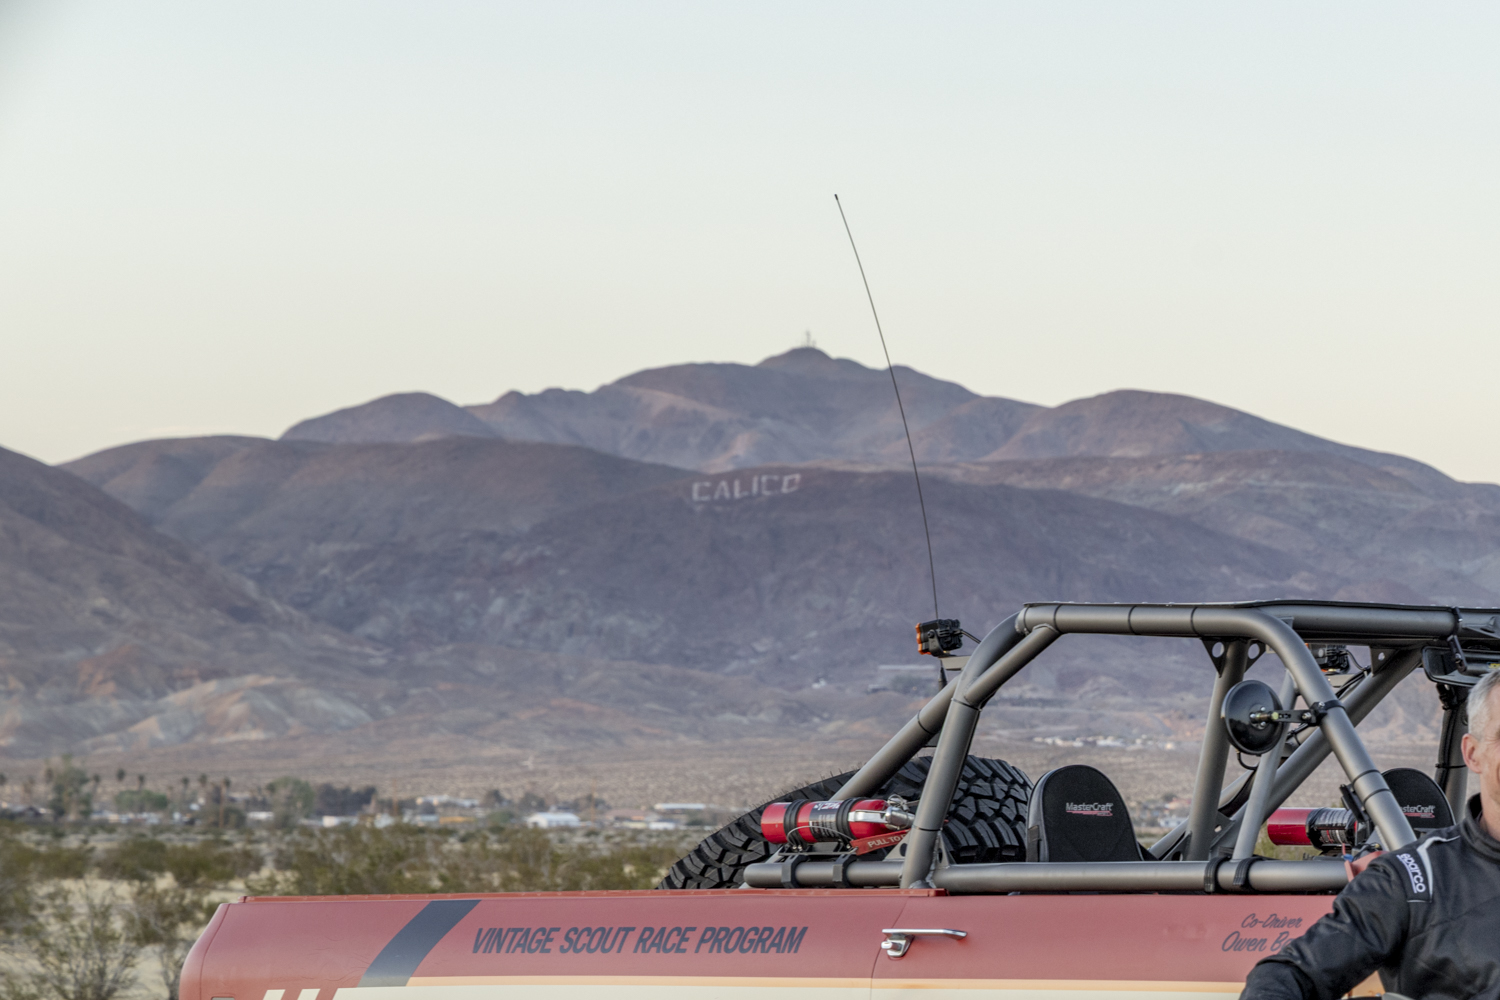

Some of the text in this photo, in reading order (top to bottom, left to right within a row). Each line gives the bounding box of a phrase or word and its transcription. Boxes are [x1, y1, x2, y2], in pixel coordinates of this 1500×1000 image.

[692, 473, 801, 501] CALICO
[867, 837, 888, 848] PULL
[1396, 853, 1426, 894] sparco
[1241, 913, 1303, 929] Co-Driver
[472, 926, 808, 953] VINTAGE SCOUT RACE PROGRAM
[1221, 930, 1267, 952] Owen
